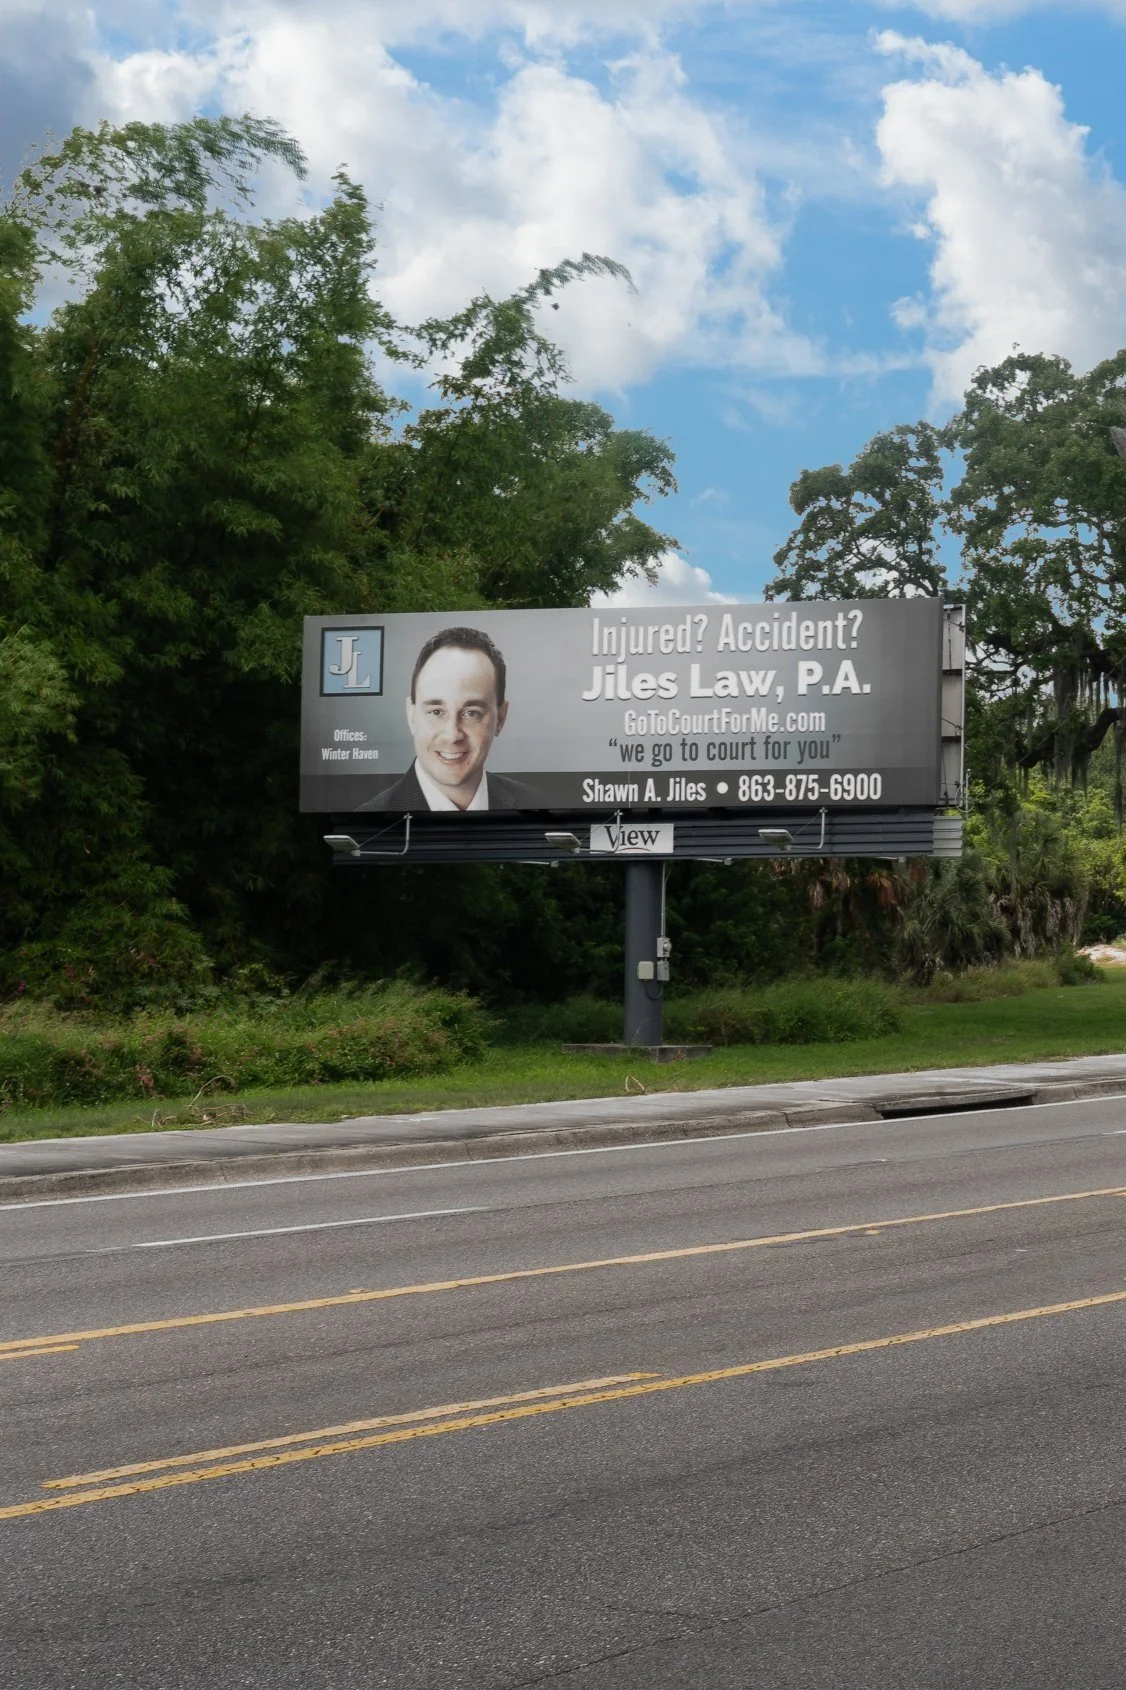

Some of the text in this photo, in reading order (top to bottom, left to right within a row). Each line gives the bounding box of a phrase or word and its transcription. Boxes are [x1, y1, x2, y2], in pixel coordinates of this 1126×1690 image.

[591, 609, 864, 663] Injured? Accident?
[582, 659, 872, 703] Jiles Law, P.A.
[333, 729, 368, 742] Offices:
[624, 707, 826, 736] GoToCourtForMe.com
[321, 747, 380, 761] Winter Haven
[651, 742, 673, 768] go
[680, 737, 699, 763] to
[706, 735, 757, 762] court
[763, 734, 791, 761] for
[582, 773, 883, 803] Shawn A. Jiles 863-875-6900
[603, 824, 661, 849] View
